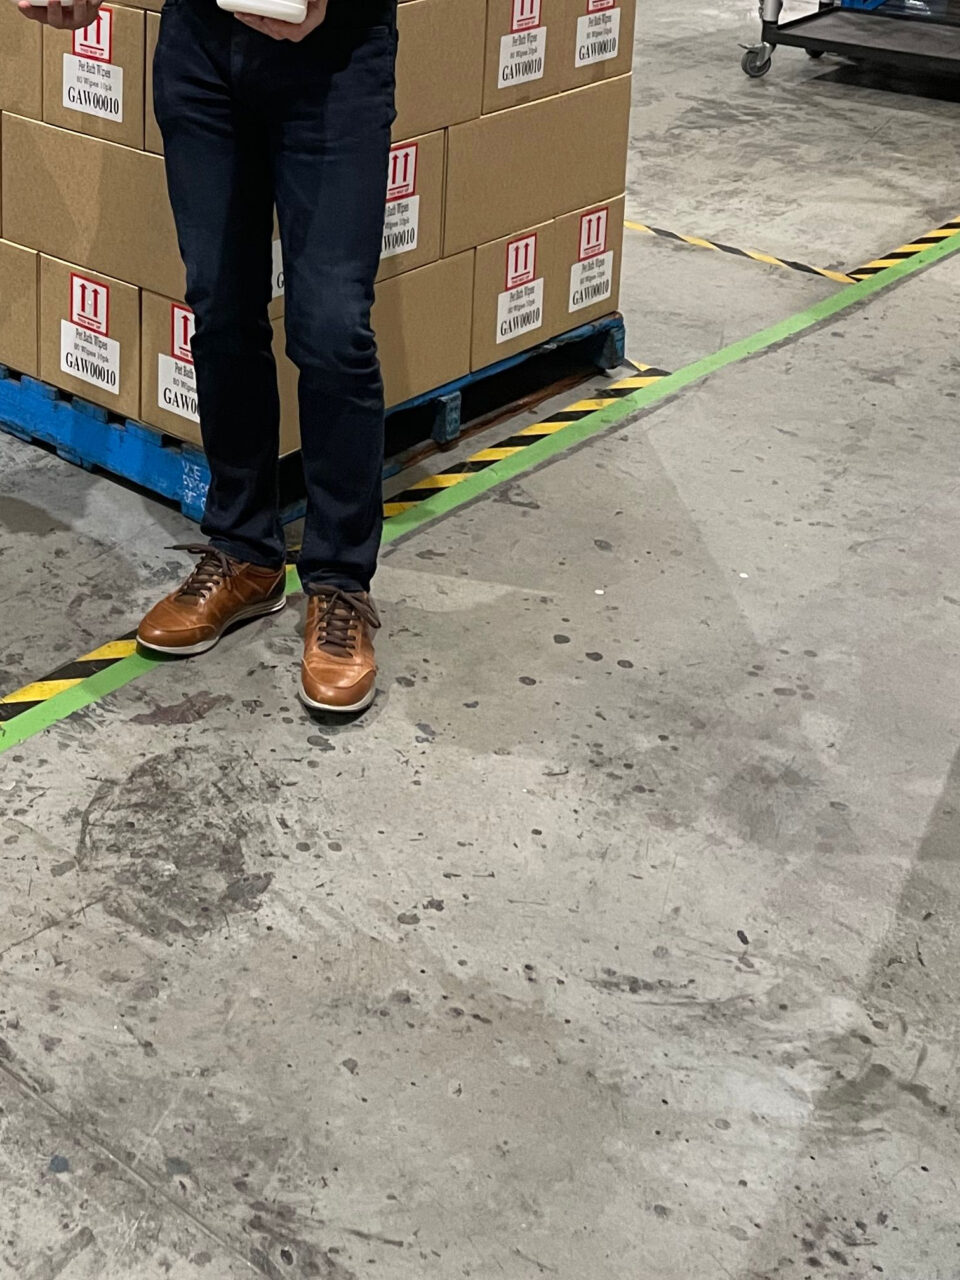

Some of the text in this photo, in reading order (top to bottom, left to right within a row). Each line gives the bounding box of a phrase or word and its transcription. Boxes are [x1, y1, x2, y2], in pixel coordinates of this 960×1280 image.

[579, 37, 616, 60] GAW00010
[86, 62, 95, 74] Bath
[96, 64, 110, 80] Wipes
[502, 57, 542, 81] GAW00010
[68, 86, 119, 114] GAW00010
[397, 202, 409, 216] Wipes
[383, 227, 415, 251] W00010
[572, 279, 609, 305] GAW00010
[500, 307, 540, 336] GAW00010
[83, 331, 93, 344] Bath
[94, 335, 107, 351] Wipes
[66, 352, 116, 386] GAW00010
[183, 365, 194, 380] Bath
[164, 387, 197, 414] GAW0
